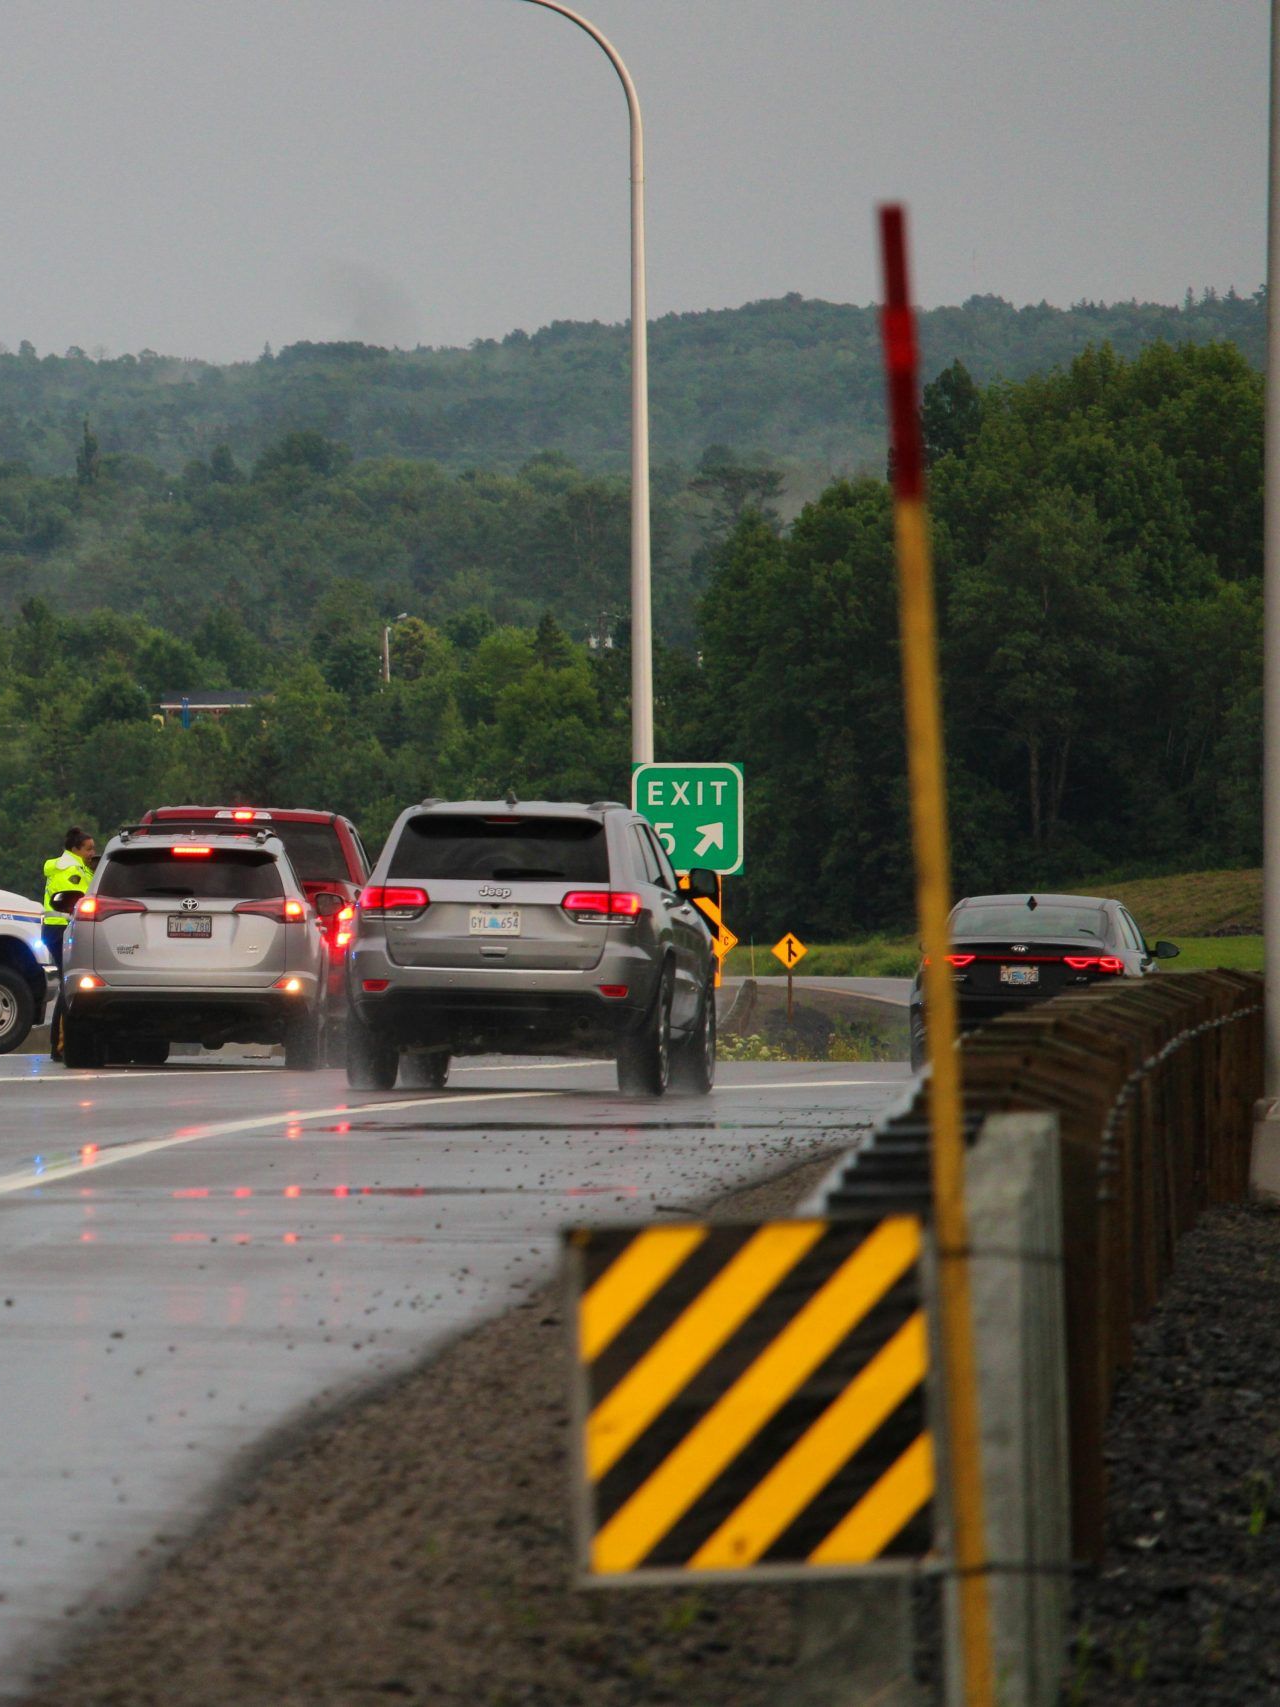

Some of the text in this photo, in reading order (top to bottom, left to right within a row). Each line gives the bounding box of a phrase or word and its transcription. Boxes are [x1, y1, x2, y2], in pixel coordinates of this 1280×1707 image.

[647, 781, 728, 806] EXIT
[479, 884, 512, 899] Jeep
[471, 916, 519, 929] GYL 654
